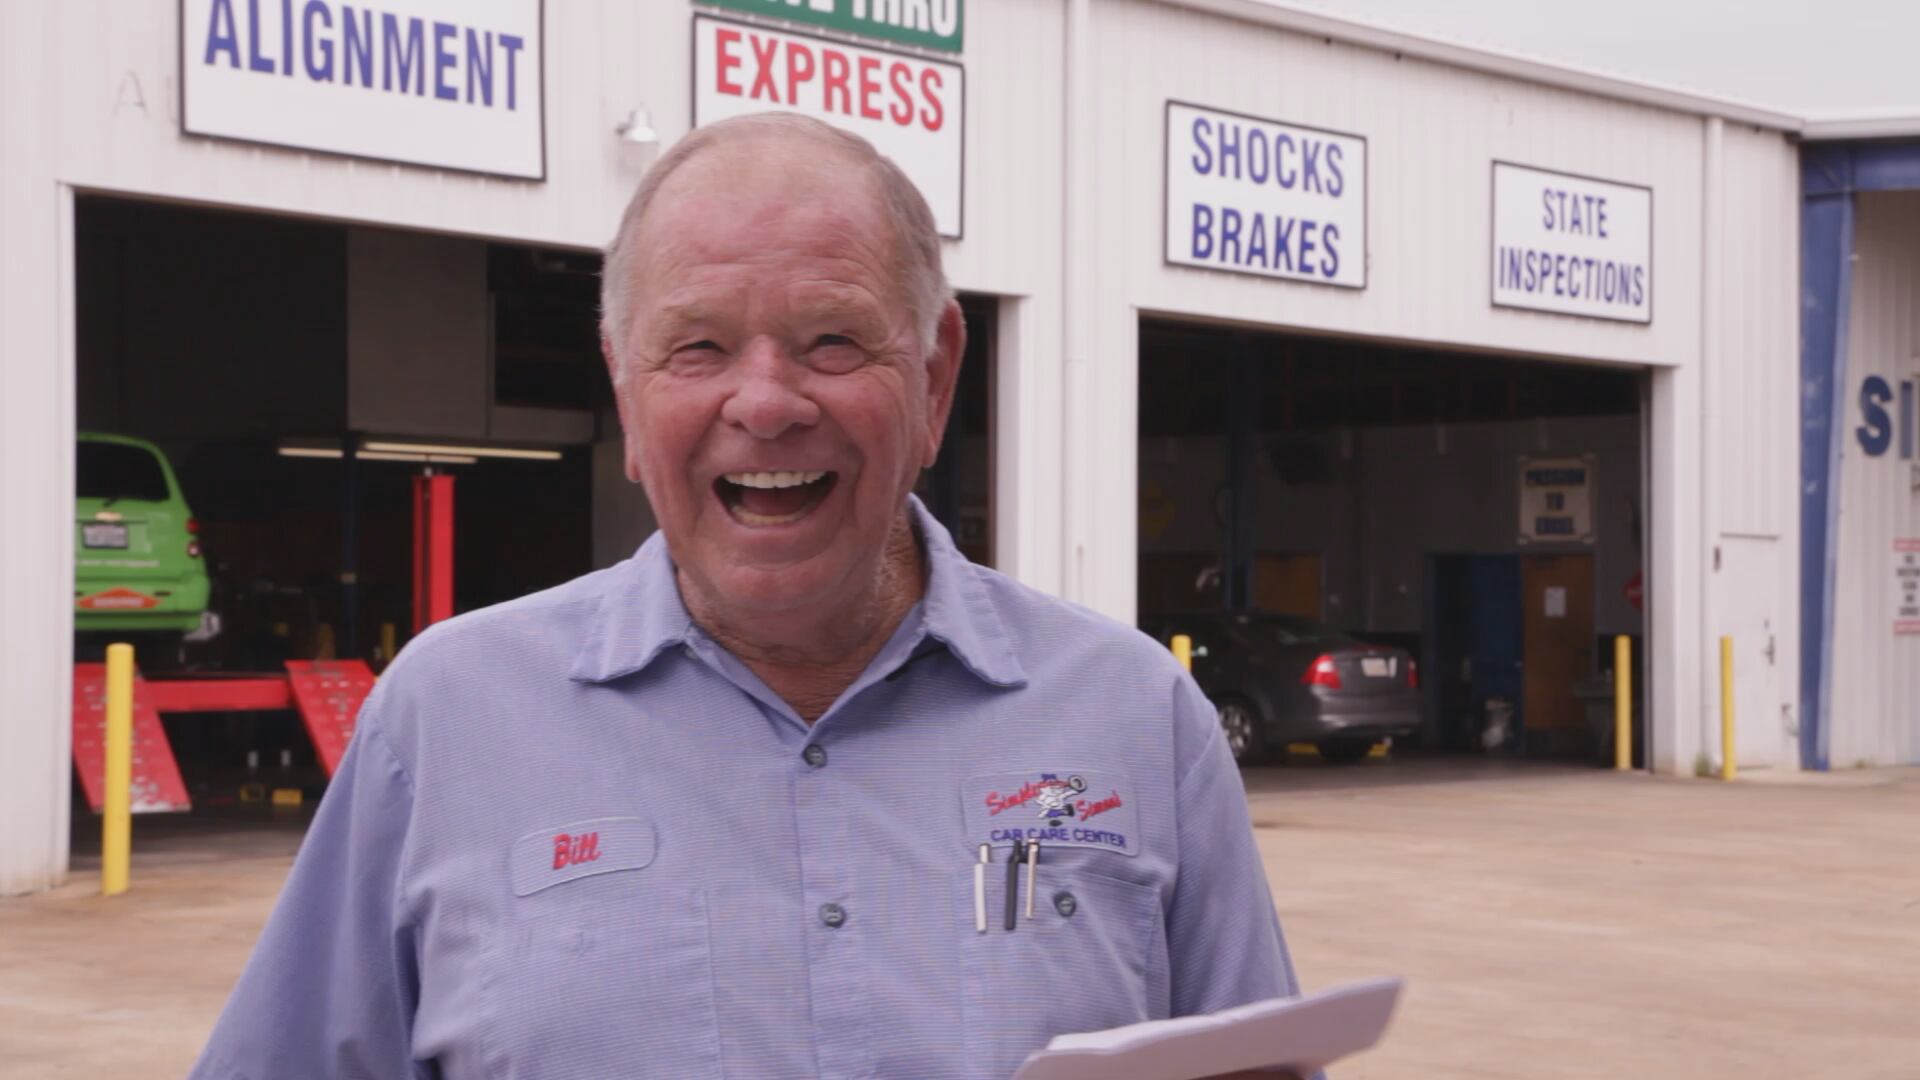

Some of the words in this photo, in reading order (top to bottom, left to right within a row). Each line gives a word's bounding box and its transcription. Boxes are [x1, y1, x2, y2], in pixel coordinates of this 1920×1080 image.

[204, 0, 524, 111] ALIGNMENT
[716, 28, 944, 132] EXPRESS
[1191, 117, 1345, 198] SHOCKS
[1191, 203, 1341, 278] BRAKES
[1542, 188, 1609, 238] STATE
[1499, 246, 1644, 307] INSPECTIONS
[552, 831, 603, 870] Bill
[990, 829, 1023, 842] CAR
[1026, 828, 1069, 841] CARE
[1072, 829, 1127, 849] CENTER
